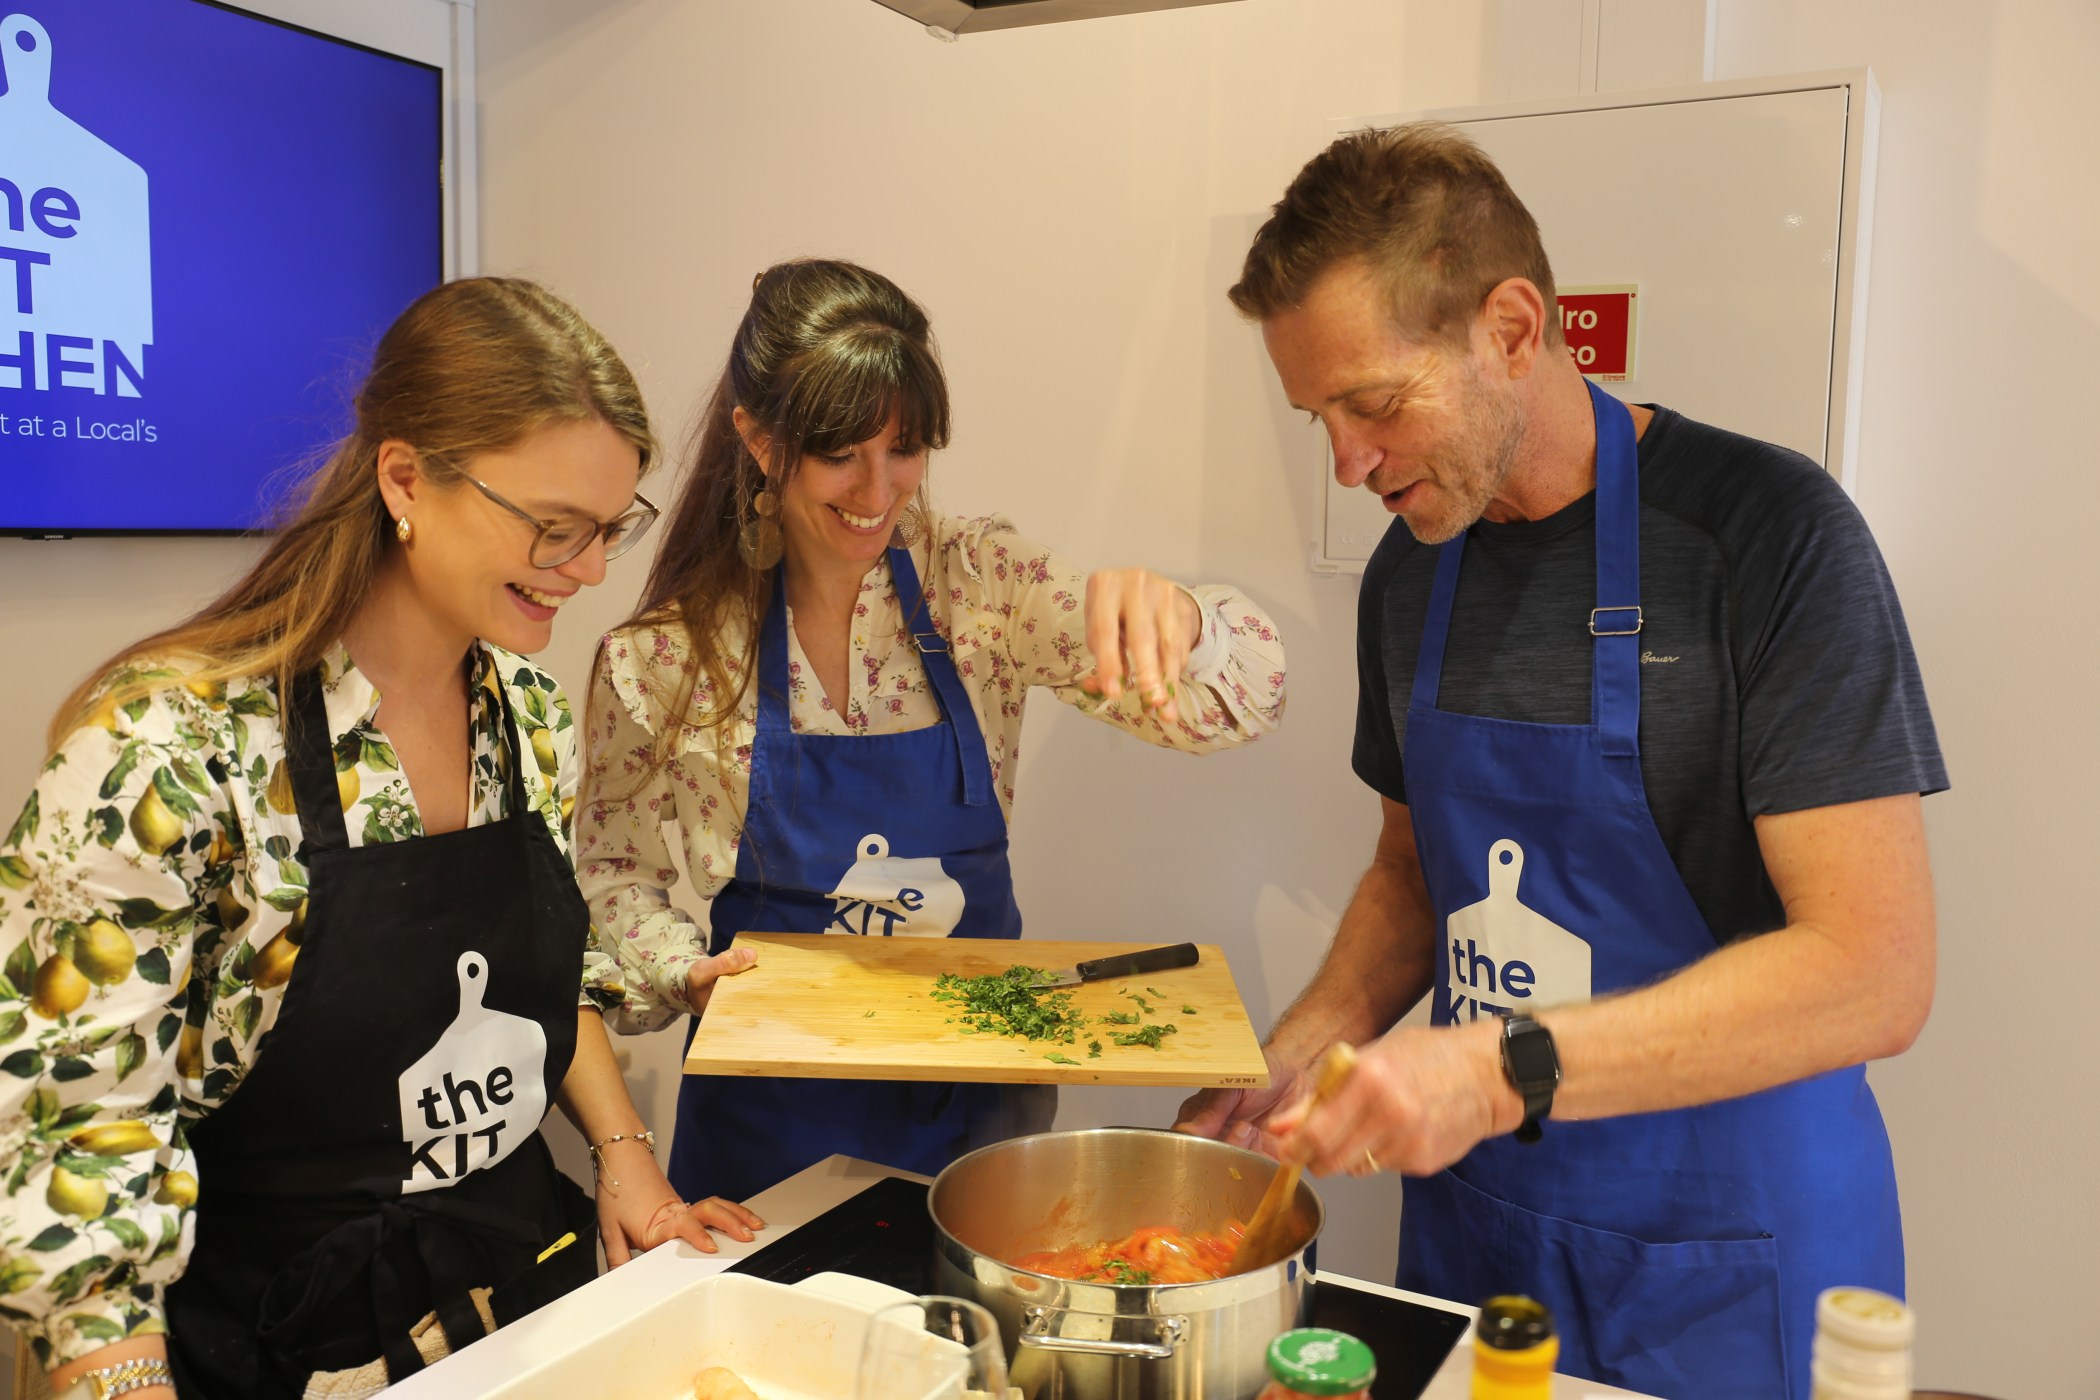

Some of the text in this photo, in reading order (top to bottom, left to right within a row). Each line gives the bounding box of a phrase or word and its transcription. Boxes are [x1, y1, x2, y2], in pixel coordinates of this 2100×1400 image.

[18, 415, 45, 437] at
[52, 419, 67, 438] a
[76, 416, 158, 443] Local's
[826, 899, 907, 937] KIT
[1452, 938, 1536, 998] the
[417, 1066, 514, 1130] the
[402, 1119, 507, 1181] KIT
